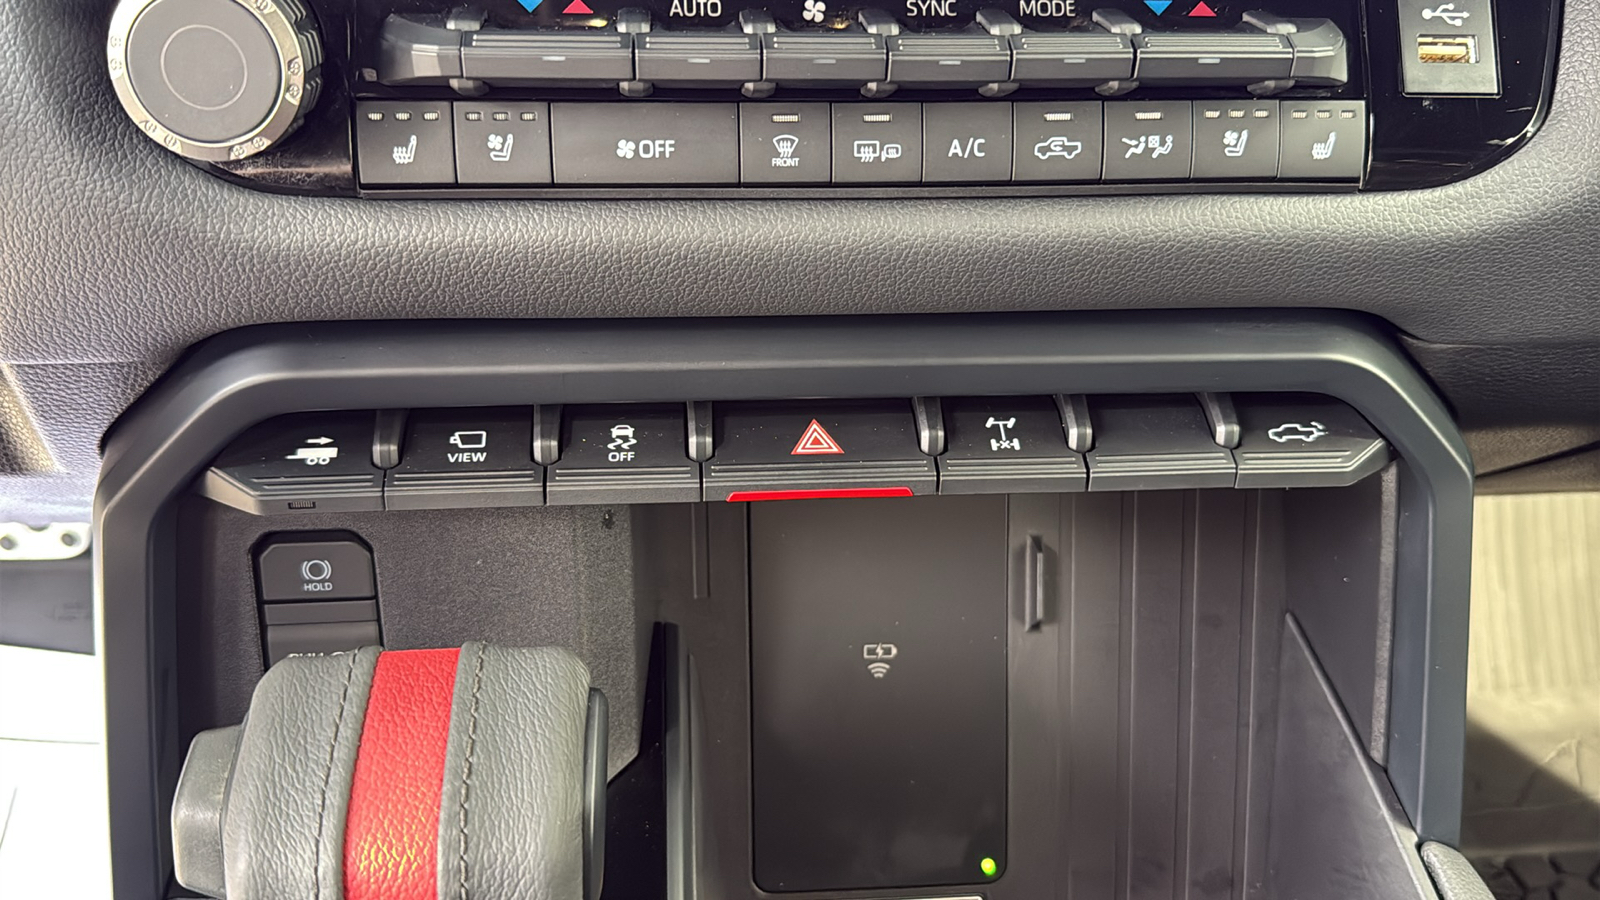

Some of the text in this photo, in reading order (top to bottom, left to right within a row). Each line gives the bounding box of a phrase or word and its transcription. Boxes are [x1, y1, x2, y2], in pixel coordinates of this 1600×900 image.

[669, 0, 722, 17] AUTO
[906, 0, 957, 17] SYNC
[1019, 0, 1076, 17] MODE
[638, 139, 675, 159] OFF
[947, 138, 986, 158] A/C
[771, 157, 800, 167] FRONT
[447, 452, 487, 463] VIEW
[607, 451, 635, 462] OFF
[303, 582, 333, 592] HOLD
